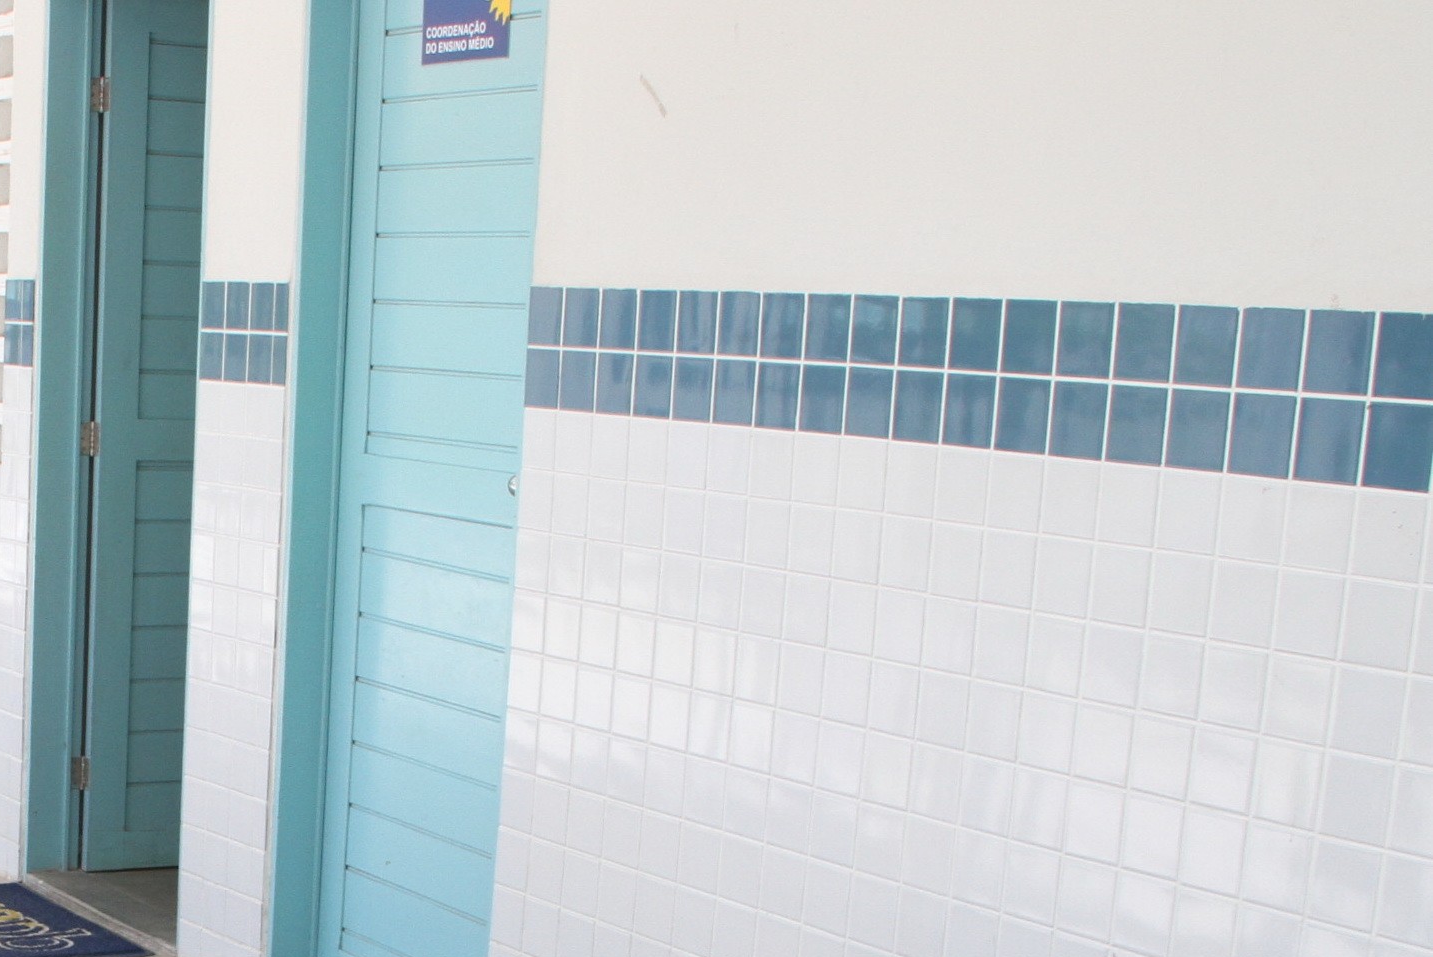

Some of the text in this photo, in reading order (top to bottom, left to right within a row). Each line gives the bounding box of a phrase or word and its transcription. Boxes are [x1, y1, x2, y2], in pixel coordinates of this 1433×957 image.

[426, 21, 487, 38] COORDENAÇÃO
[425, 36, 494, 54] DO ENSINO MÉDIO
